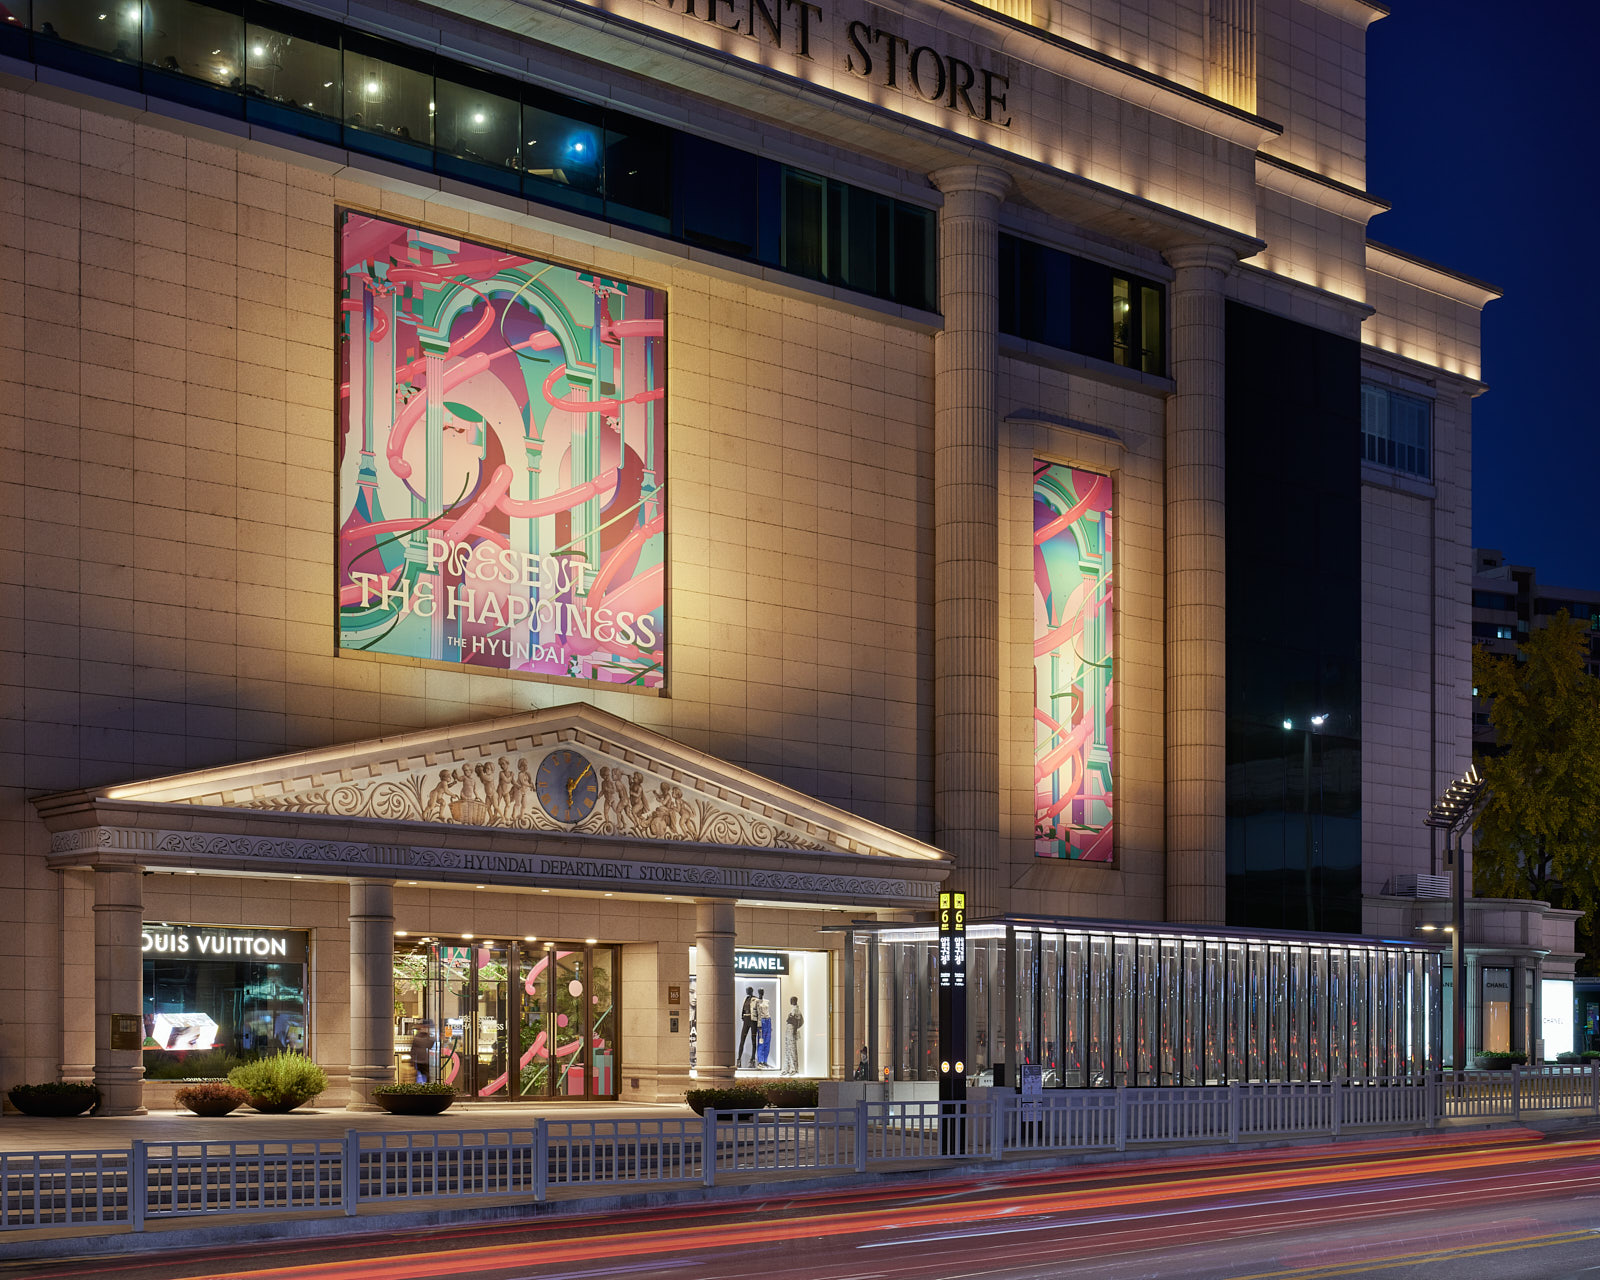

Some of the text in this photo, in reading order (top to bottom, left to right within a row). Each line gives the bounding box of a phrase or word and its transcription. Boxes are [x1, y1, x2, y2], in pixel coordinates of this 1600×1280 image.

[651, 0, 1012, 128] ENT STORE
[426, 537, 592, 595] PRESENT
[352, 571, 657, 648] THE HAPPINESS
[447, 635, 565, 665] THE HYUNDAI
[463, 854, 682, 882] HYUNDAI DEPARTMENT STORE
[941, 910, 949, 923] 6
[955, 910, 963, 923] 6
[141, 933, 286, 956] OUIS VUITTON
